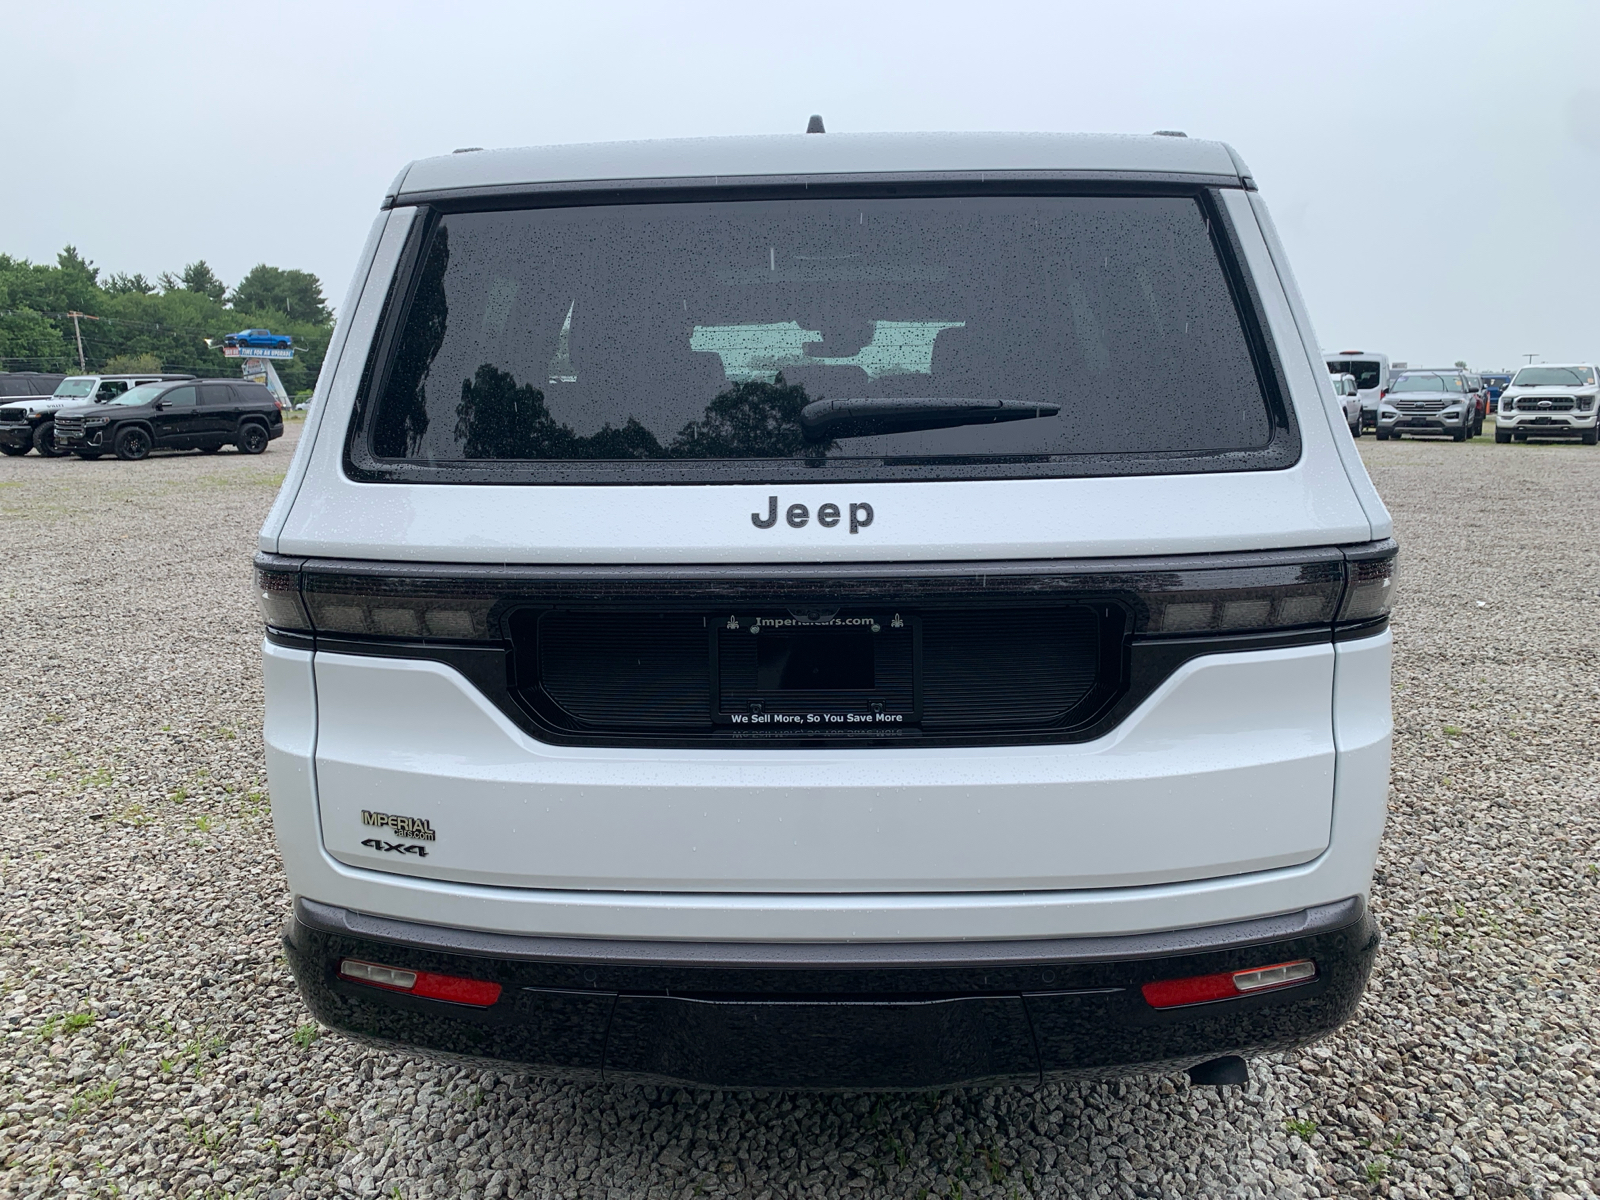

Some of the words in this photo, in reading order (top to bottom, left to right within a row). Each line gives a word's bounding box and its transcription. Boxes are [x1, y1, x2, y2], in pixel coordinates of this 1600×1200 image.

[751, 496, 874, 534] Jeep
[755, 617, 874, 628] Imperrs.com
[731, 714, 749, 723] We
[751, 714, 770, 723] Sell
[774, 714, 804, 724] More,
[806, 713, 820, 723] So
[824, 713, 844, 722] You
[846, 713, 873, 722] Save
[876, 713, 903, 722] More
[361, 810, 435, 834] IMPERIAL
[393, 828, 435, 841] cars.com
